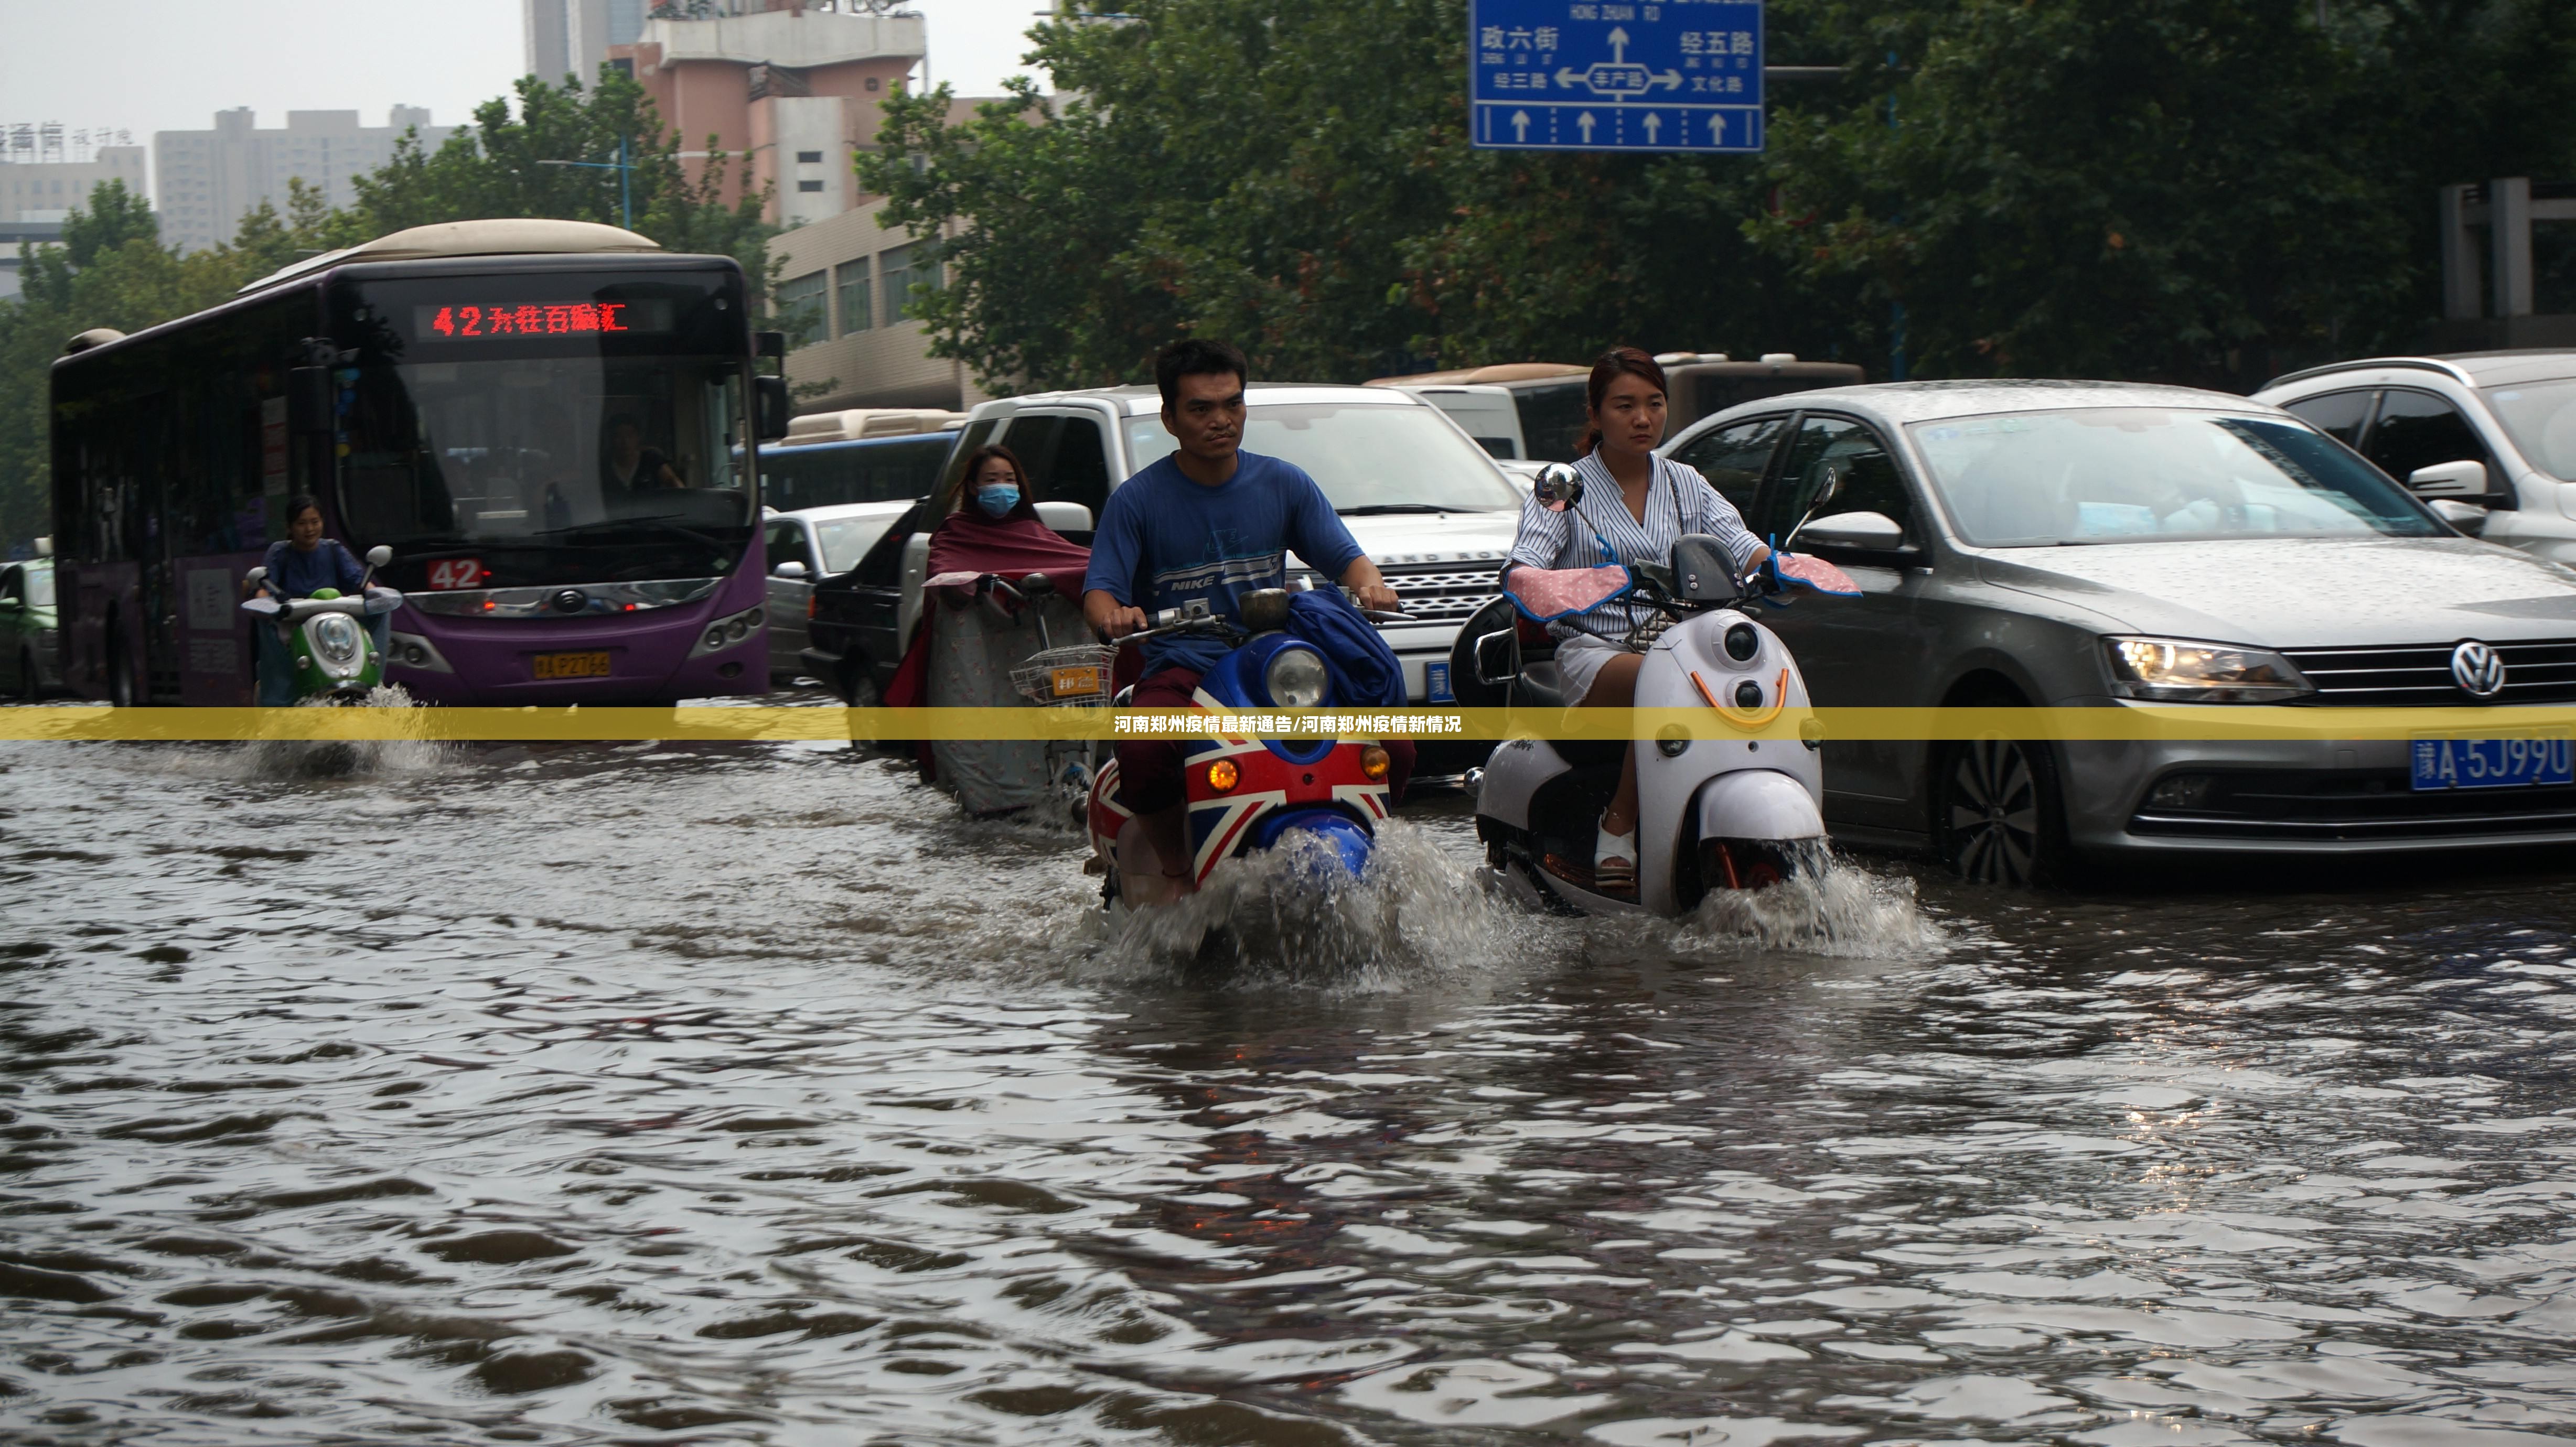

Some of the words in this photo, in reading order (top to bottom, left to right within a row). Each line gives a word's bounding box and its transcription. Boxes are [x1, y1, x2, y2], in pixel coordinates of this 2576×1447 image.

[1481, 26, 1559, 51] 政六街
[1680, 31, 1754, 55] 经五路
[1494, 72, 1548, 89] 经三路
[1593, 71, 1644, 88] 丰产路
[1691, 77, 1743, 92] 文化路
[434, 307, 481, 336] 42
[1382, 554, 1439, 564] AND
[432, 560, 480, 588] 42
[1171, 576, 1215, 591] NIKE
